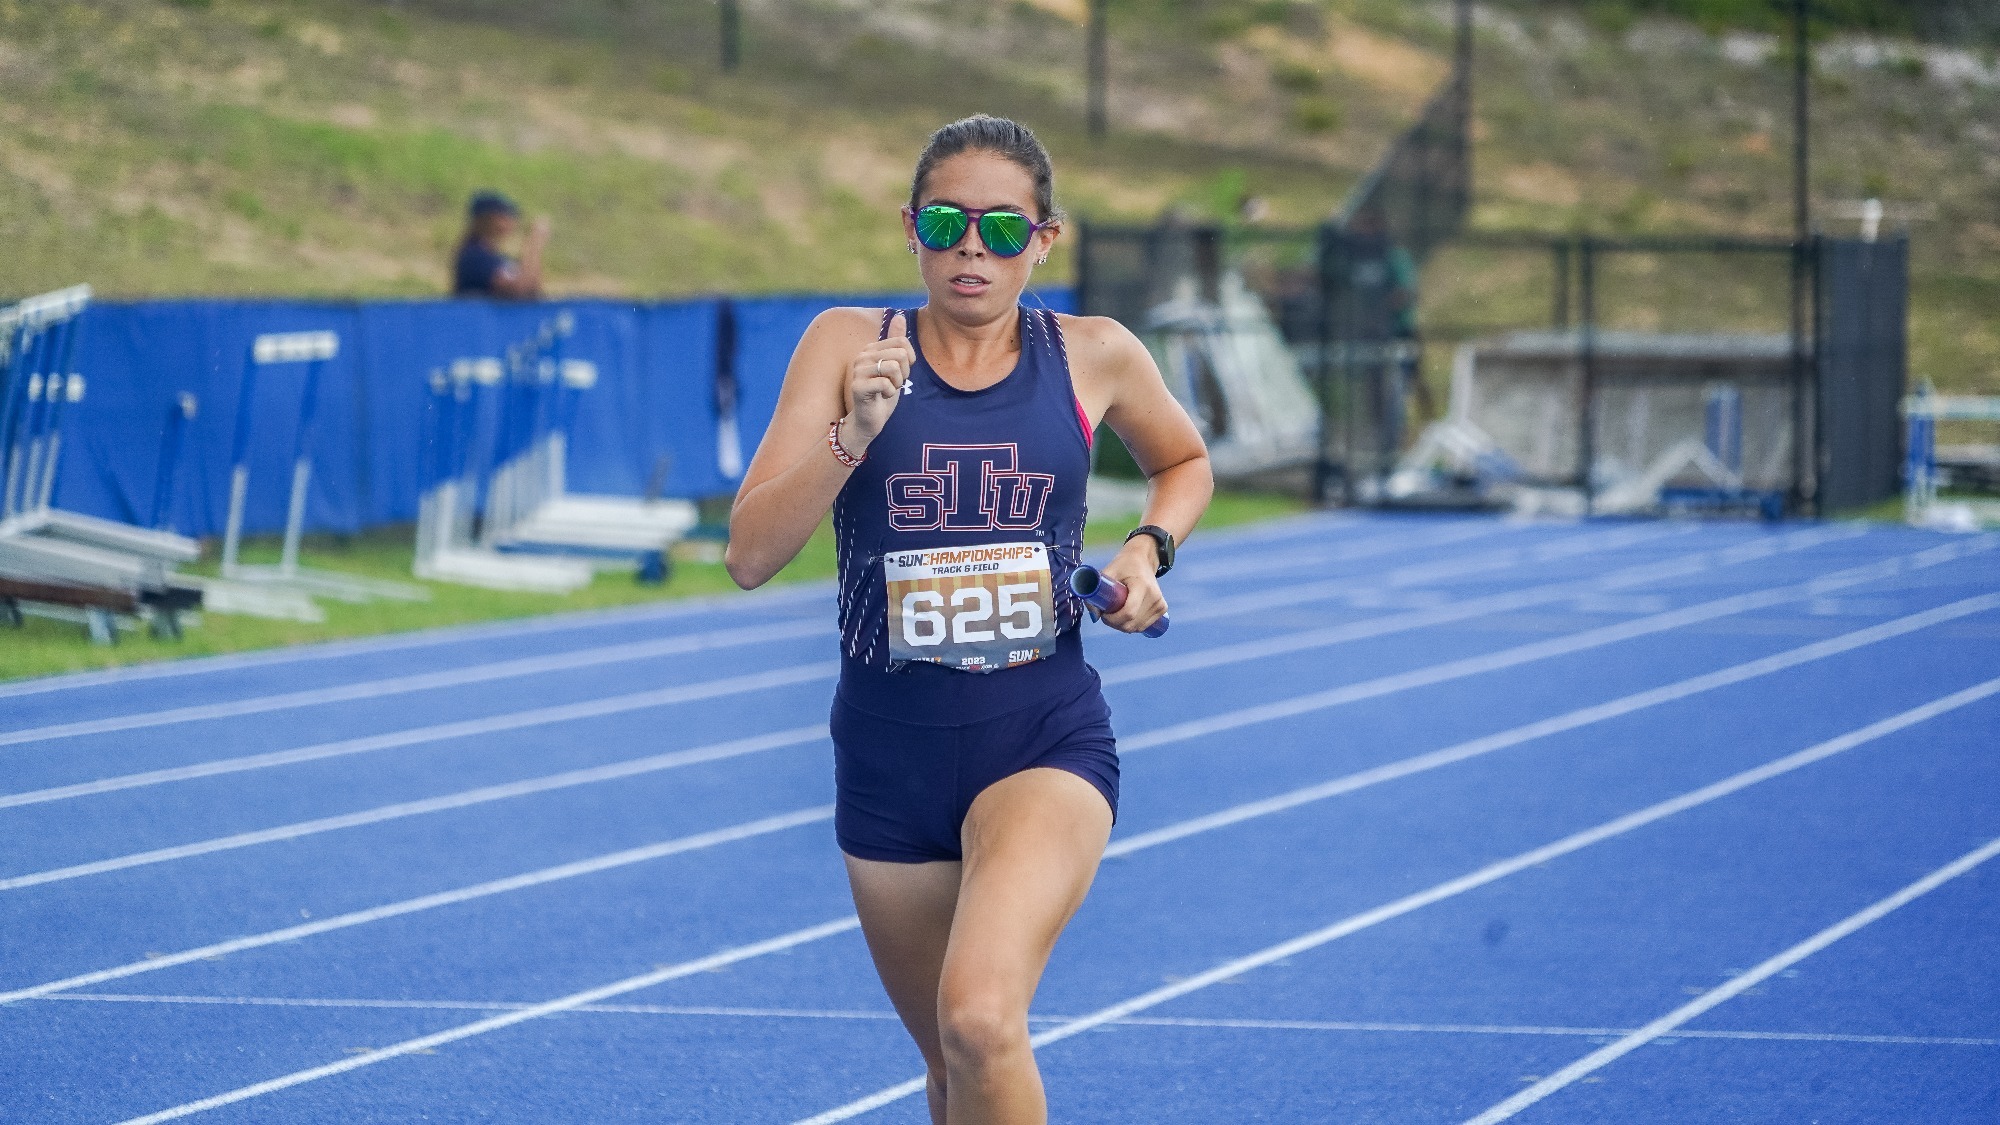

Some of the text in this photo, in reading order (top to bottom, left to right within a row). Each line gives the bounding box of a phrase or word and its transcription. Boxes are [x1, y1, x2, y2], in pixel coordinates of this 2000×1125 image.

[886, 443, 1055, 531] STU
[932, 566, 962, 575] TRACK
[973, 563, 1000, 572] FIELD
[902, 582, 1043, 647] 625
[961, 656, 986, 665] 2023
